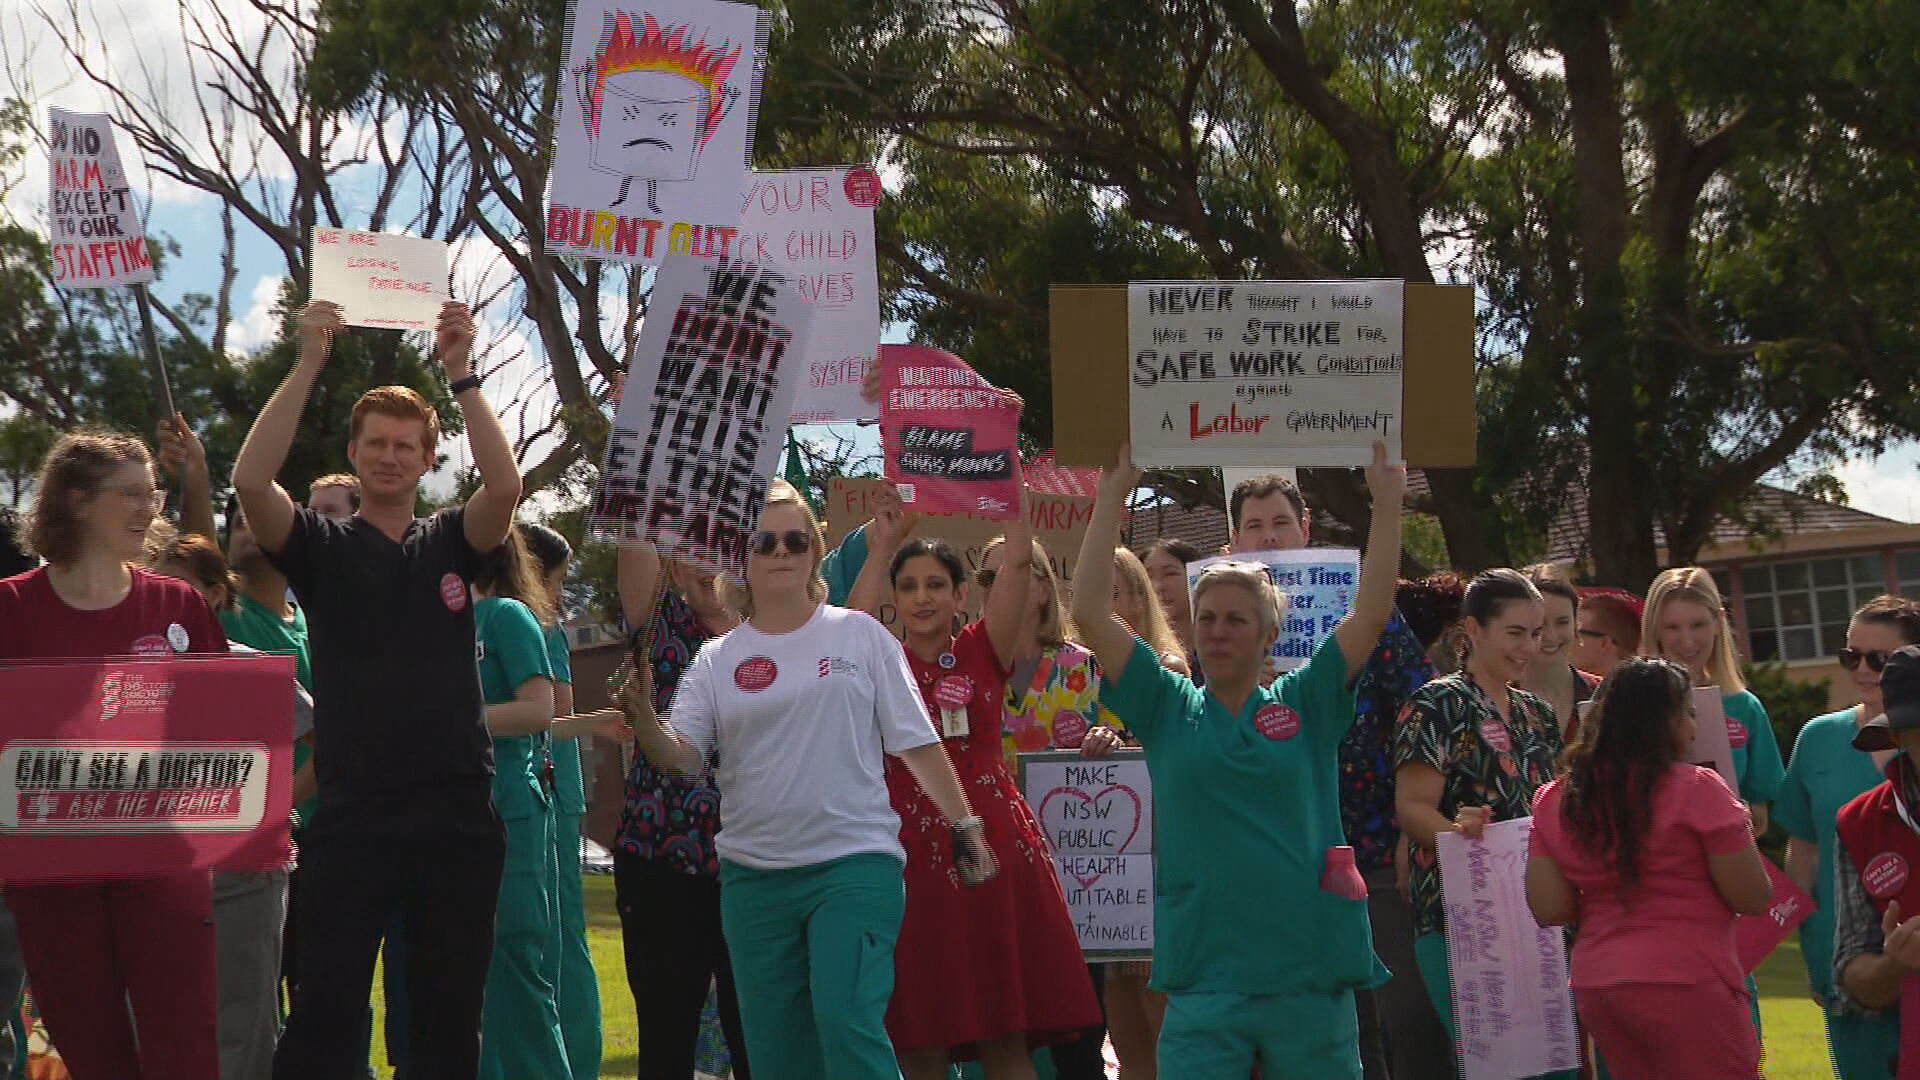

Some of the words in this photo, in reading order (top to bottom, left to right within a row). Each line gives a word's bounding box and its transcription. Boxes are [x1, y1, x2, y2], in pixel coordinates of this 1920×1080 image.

[50, 118, 68, 152] DO
[72, 126, 101, 156] NO
[54, 187, 130, 216] EXCEPT
[740, 176, 832, 216] YOUR
[58, 217, 75, 238] TO
[79, 215, 124, 239] OUR
[317, 230, 341, 245] WE
[347, 232, 379, 247] ARE
[546, 203, 664, 259] BURNT
[668, 221, 739, 261] OUT
[52, 235, 151, 281] STAFFING
[738, 230, 773, 265] CK
[786, 229, 856, 263] CHILD
[347, 257, 400, 272] LOSING
[798, 272, 855, 303] RVES
[1148, 287, 1234, 315] NEVER
[1247, 294, 1300, 311] THOUGHT
[1330, 296, 1374, 311] WOULD
[666, 293, 792, 386] DONT
[1152, 328, 1187, 346] HAVE
[1204, 327, 1223, 343] TO
[1242, 318, 1341, 347] STRIKE
[1357, 325, 1388, 343] FOR
[898, 365, 975, 387] WAITING
[1133, 350, 1217, 387] SAFE
[1229, 350, 1305, 376] WORK
[1316, 353, 1402, 376] CONDITIONS
[654, 339, 779, 431] WANT
[1236, 382, 1293, 404] against
[1161, 411, 1174, 431] A
[1189, 402, 1271, 440] Labor
[1286, 409, 1394, 437] GOVERNMENT
[905, 425, 968, 450] BLAME
[901, 450, 946, 476] CHRIS
[949, 452, 1005, 476] MINNS
[605, 427, 767, 532] EITHER
[1272, 566, 1304, 586] irst
[1308, 565, 1353, 586] Time
[15, 750, 83, 789] CAN'T
[88, 751, 128, 789] SEE
[134, 751, 150, 789] A
[157, 752, 254, 789] DOCTOR?
[1065, 764, 1120, 786] MAKE
[66, 791, 109, 821] ASK
[114, 790, 148, 818] THE
[152, 787, 233, 818] PREMIER
[1063, 799, 1113, 820] NSW
[1057, 829, 1118, 849] PUBLIC
[1060, 857, 1126, 877] HEALTH
[1066, 888, 1147, 907] UTITABLE
[1076, 923, 1149, 942] TAINABLE
[1452, 903, 1477, 963] SAFE
[1472, 899, 1501, 963] NSW
[1480, 970, 1511, 1038] Health
